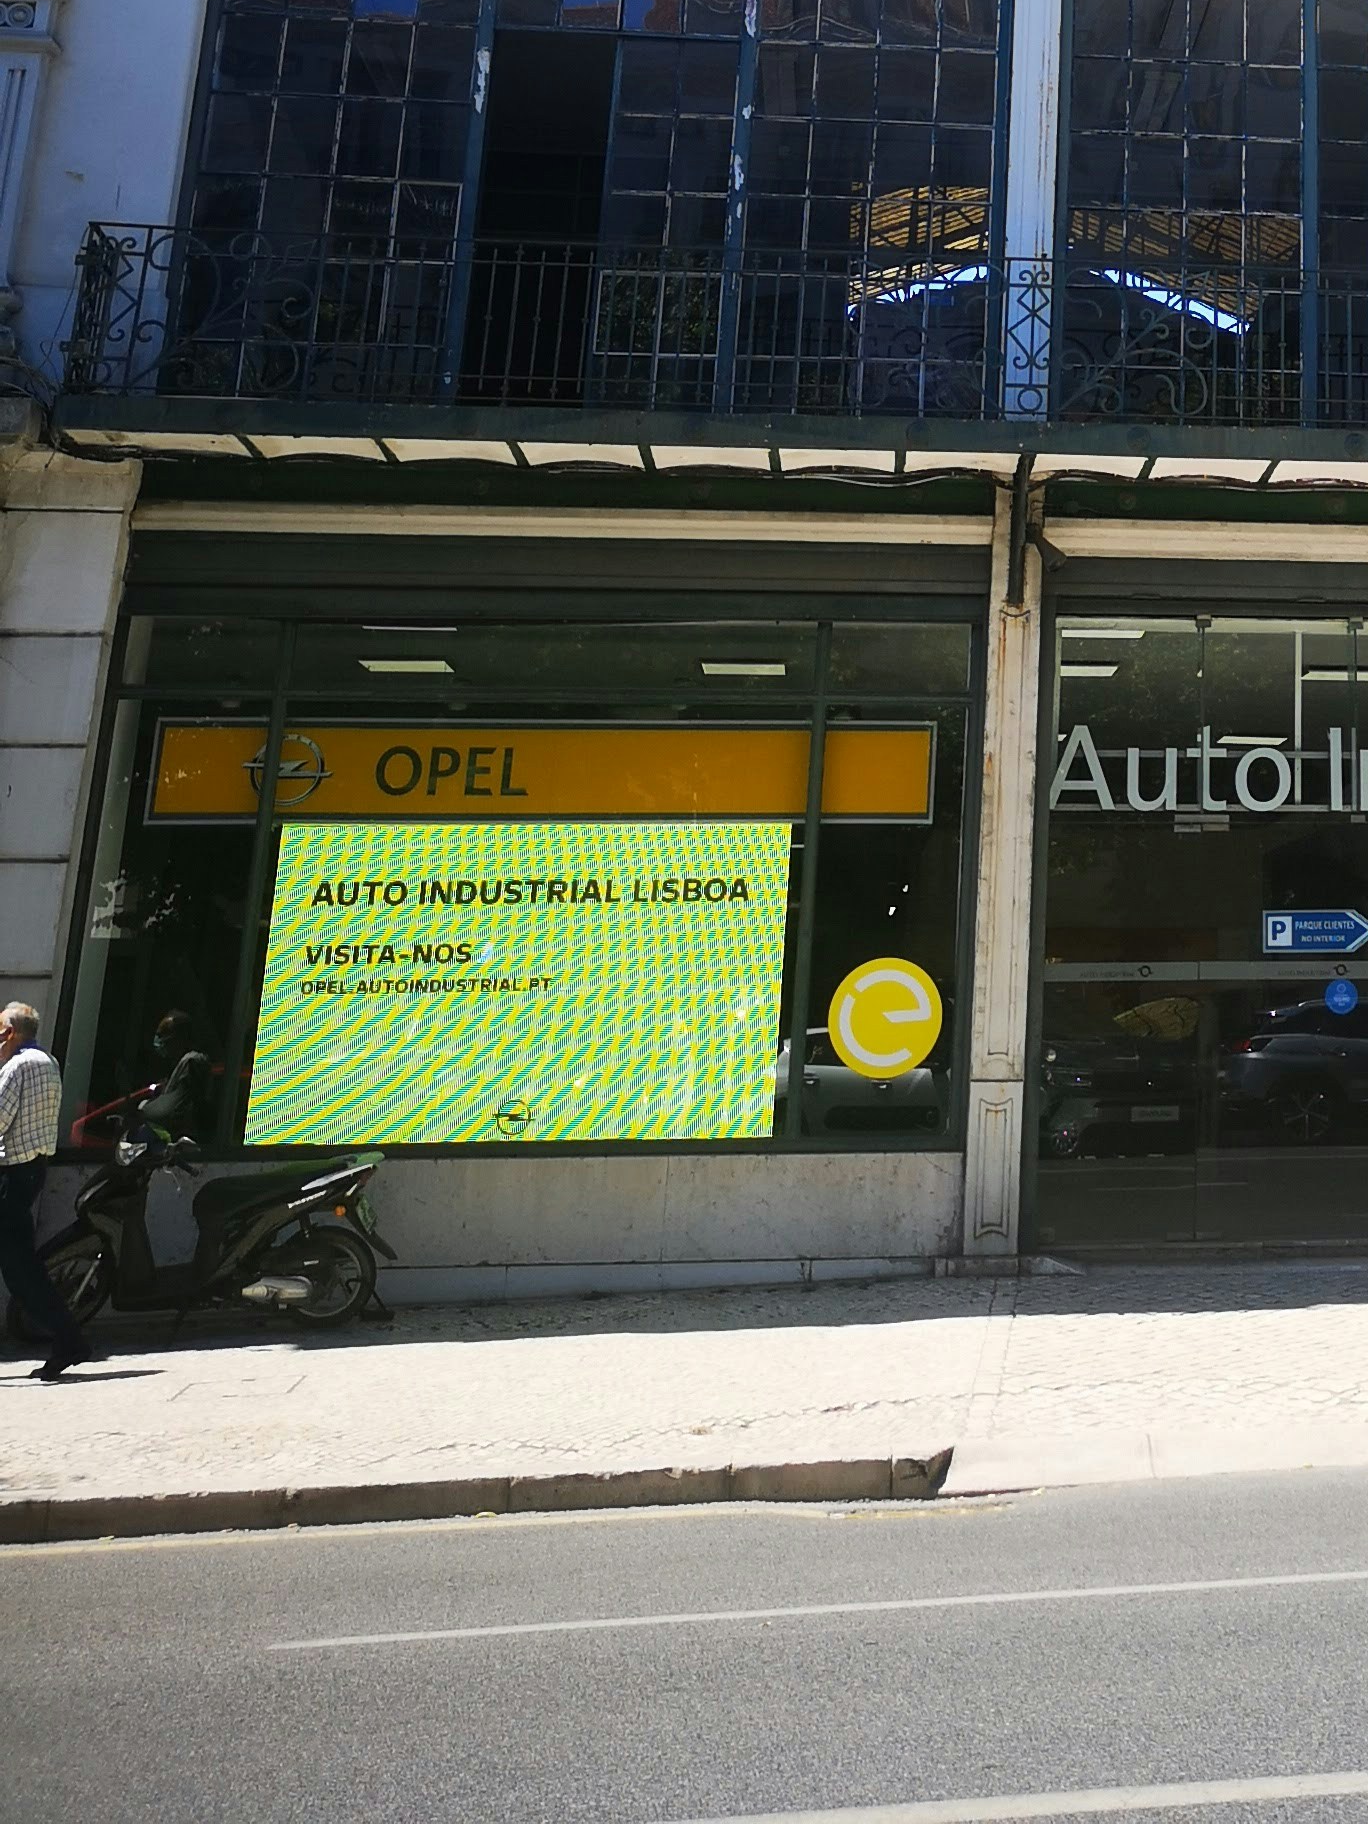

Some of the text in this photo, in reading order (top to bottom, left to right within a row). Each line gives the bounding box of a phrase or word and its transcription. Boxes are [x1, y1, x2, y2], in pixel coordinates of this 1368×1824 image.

[374, 745, 529, 797] OPEL
[1050, 724, 1292, 812] Auto
[311, 877, 750, 907] AUTO INDUSTRIAL LISBOA
[1295, 920, 1355, 930] PARQUE CLIENTES
[1301, 934, 1346, 943] NO INTERIOR
[305, 942, 473, 966] VISITA-NOS
[300, 977, 552, 995] OPEL.AUTOINDUSTRIAL.PT
